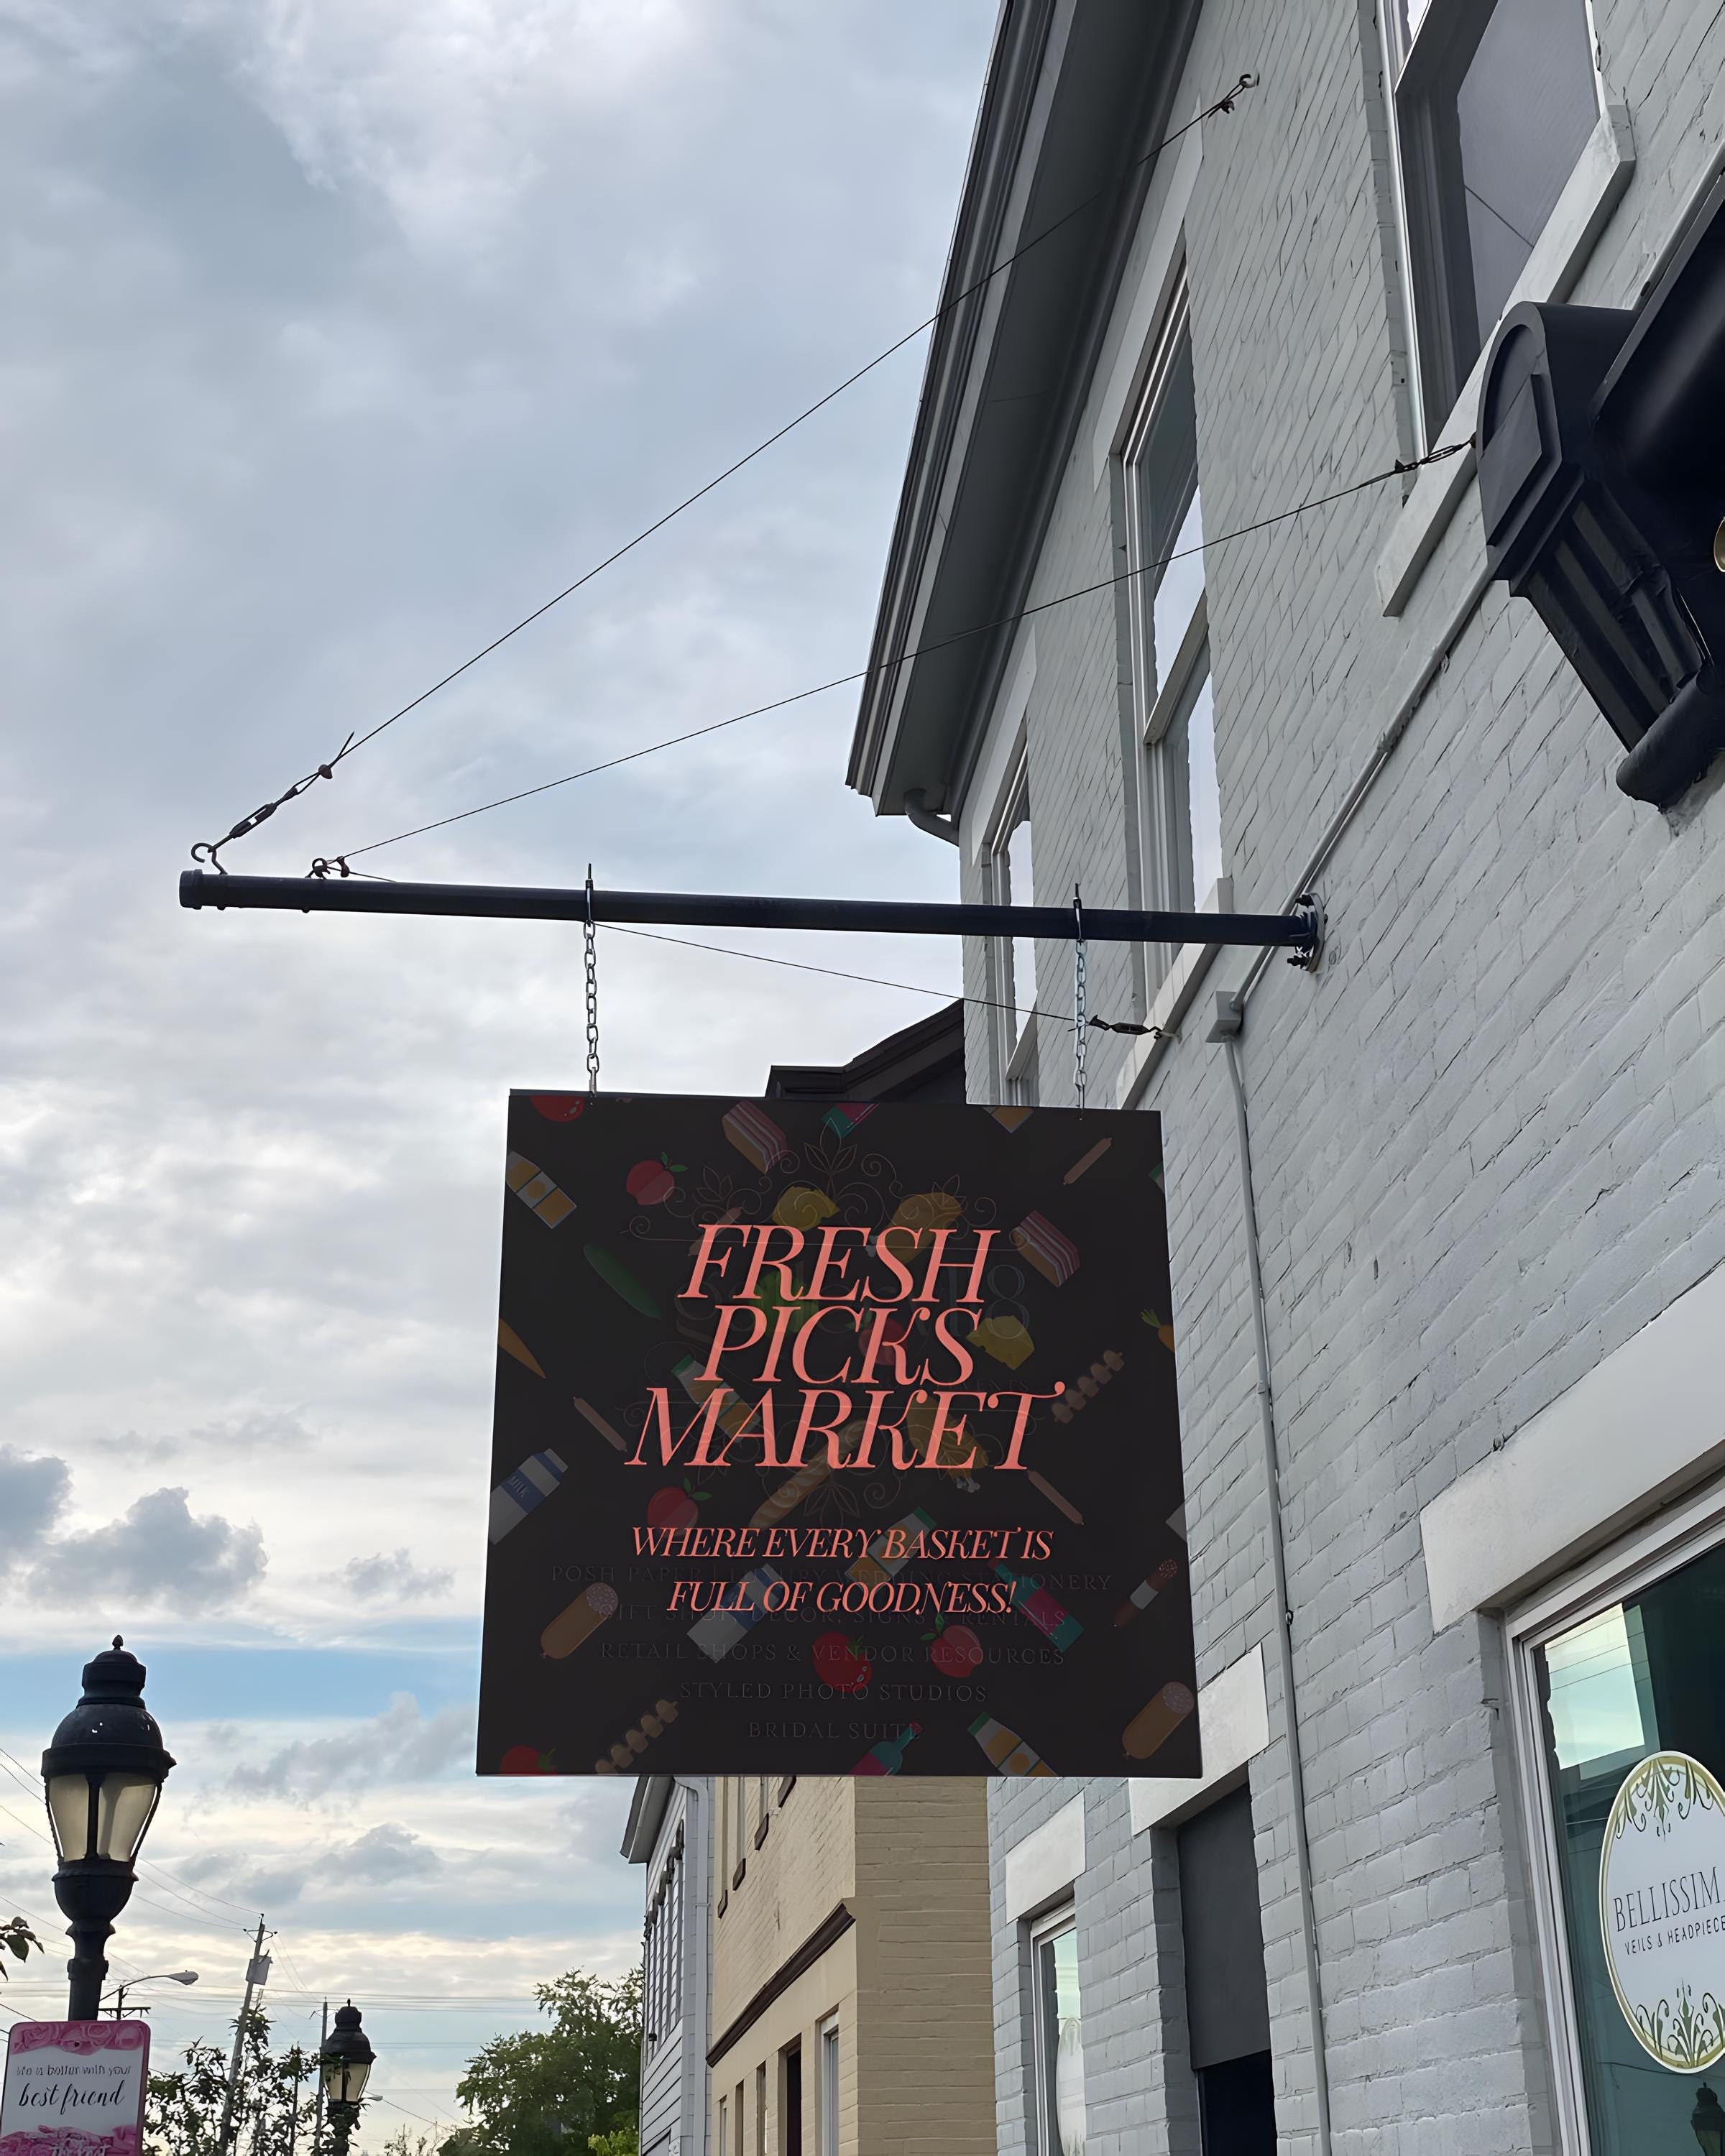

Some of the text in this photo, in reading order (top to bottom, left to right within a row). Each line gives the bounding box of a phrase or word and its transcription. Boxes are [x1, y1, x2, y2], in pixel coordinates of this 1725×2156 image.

[677, 1224, 1001, 1303] FRESH
[693, 1304, 983, 1386] PICKS
[624, 1381, 1067, 1470] MARKET
[632, 1526, 1054, 1560] WHERE EVERY BASKET IS
[551, 1565, 615, 1582] POSH
[666, 1581, 755, 1611] FULL
[763, 1581, 814, 1613] OF
[816, 1581, 1016, 1616] GOODNESS!
[600, 1643, 689, 1659] RETAIL
[679, 1682, 988, 1703] STYLED PHOTO STUDIOS
[748, 1722, 840, 1738] BRIDAL
[19, 2079, 126, 2115] best friend
